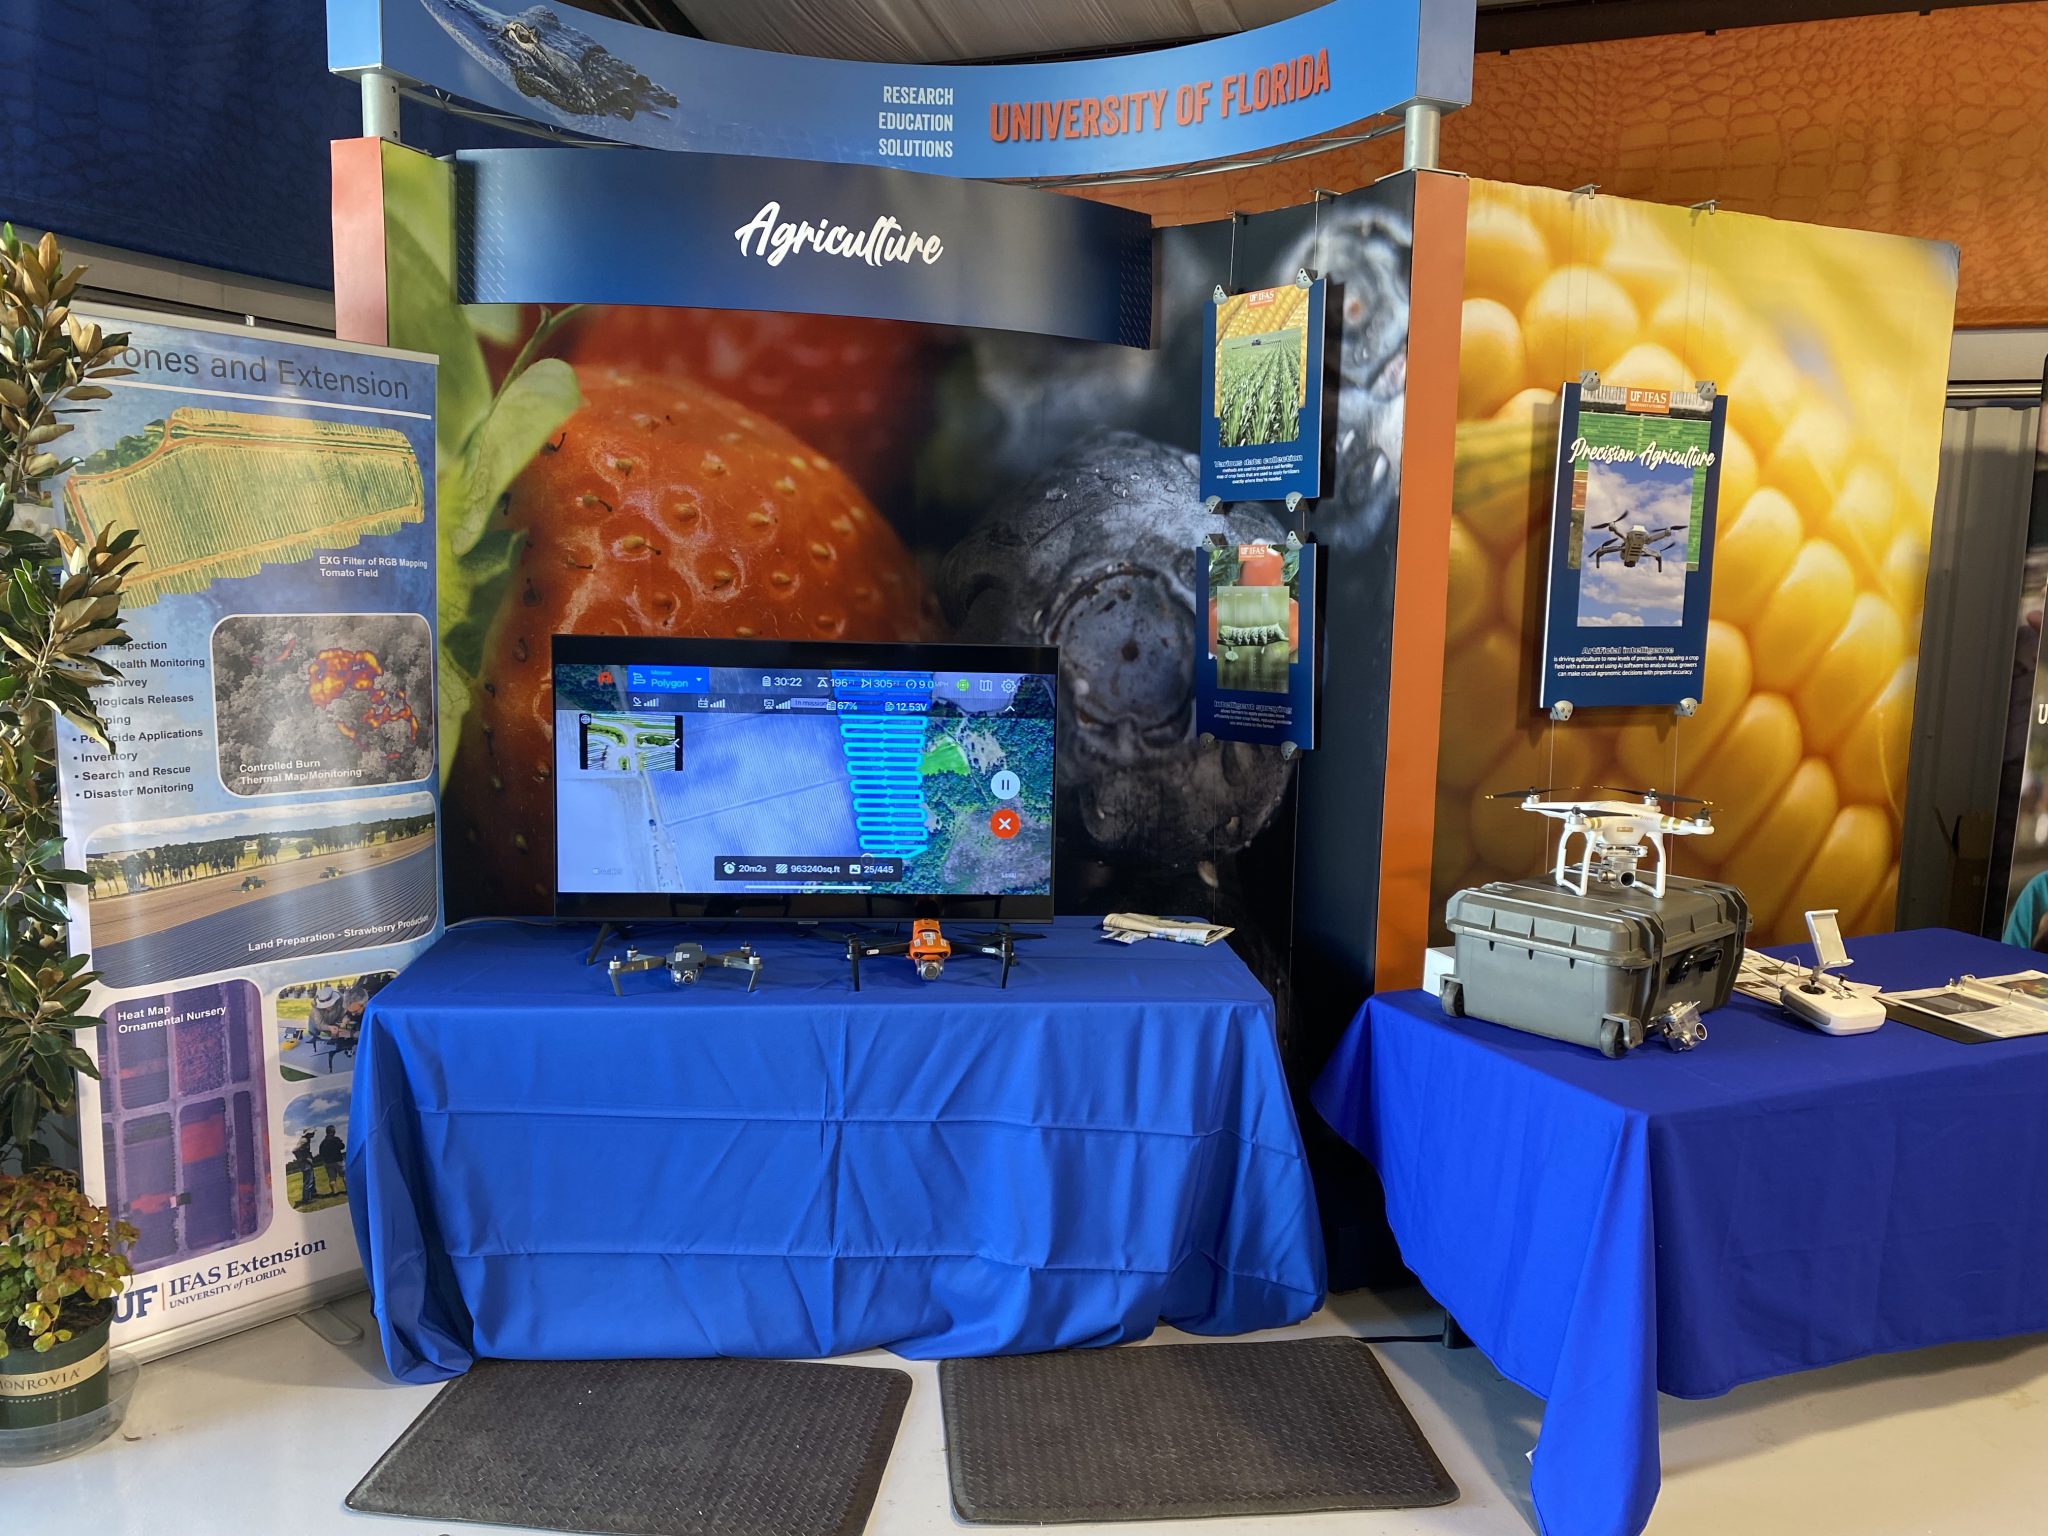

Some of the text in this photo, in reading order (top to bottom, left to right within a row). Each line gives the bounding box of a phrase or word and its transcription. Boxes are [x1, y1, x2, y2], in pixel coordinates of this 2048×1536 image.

[883, 84, 954, 106] RESEARCH
[989, 47, 1330, 143] UNIVERSITY OF FLORIDA
[878, 111, 954, 132] EDUCATION
[878, 137, 954, 159] SOLUTIONS
[734, 201, 944, 267] Agriculture
[110, 345, 409, 400] ones and Extension
[1630, 390, 1667, 404] UF IFAS
[1568, 436, 1716, 471] Precision Agriculture
[319, 556, 428, 569] EXG Filter of RGB Mapping
[320, 568, 379, 578] Tomato Field
[111, 657, 206, 669] Health Monitoring
[109, 678, 147, 689] Survey
[651, 679, 689, 689] Polygon
[773, 677, 803, 687] 30:22
[830, 678, 848, 688] 196
[873, 680, 893, 689] 305
[918, 680, 935, 689] 9.0
[93, 693, 194, 708] ologicals Releases
[837, 701, 858, 711] 67%
[895, 702, 927, 712] 12.53V
[105, 715, 131, 726] ping
[80, 728, 204, 744] Peicide Applications
[81, 752, 138, 762] Inventory
[82, 765, 191, 781] Search and Rescue
[239, 759, 321, 774] Controlled Burn
[240, 767, 362, 786] Thermal Map/Monitoring
[83, 782, 194, 799] Disaster Monitoring
[738, 864, 767, 874] 20m2s
[863, 865, 894, 875] 25/445
[248, 939, 274, 951] Land
[276, 932, 335, 947] Preparation
[344, 922, 396, 938] Strawberry
[397, 914, 429, 930] Production
[117, 1004, 171, 1022] Heat Map
[118, 1005, 227, 1034] Ornamental Nursery
[168, 1238, 327, 1298] IFAS Extension
[169, 1267, 287, 1309] UNIVERSITY of FLORIDA
[111, 1284, 158, 1324] UF
